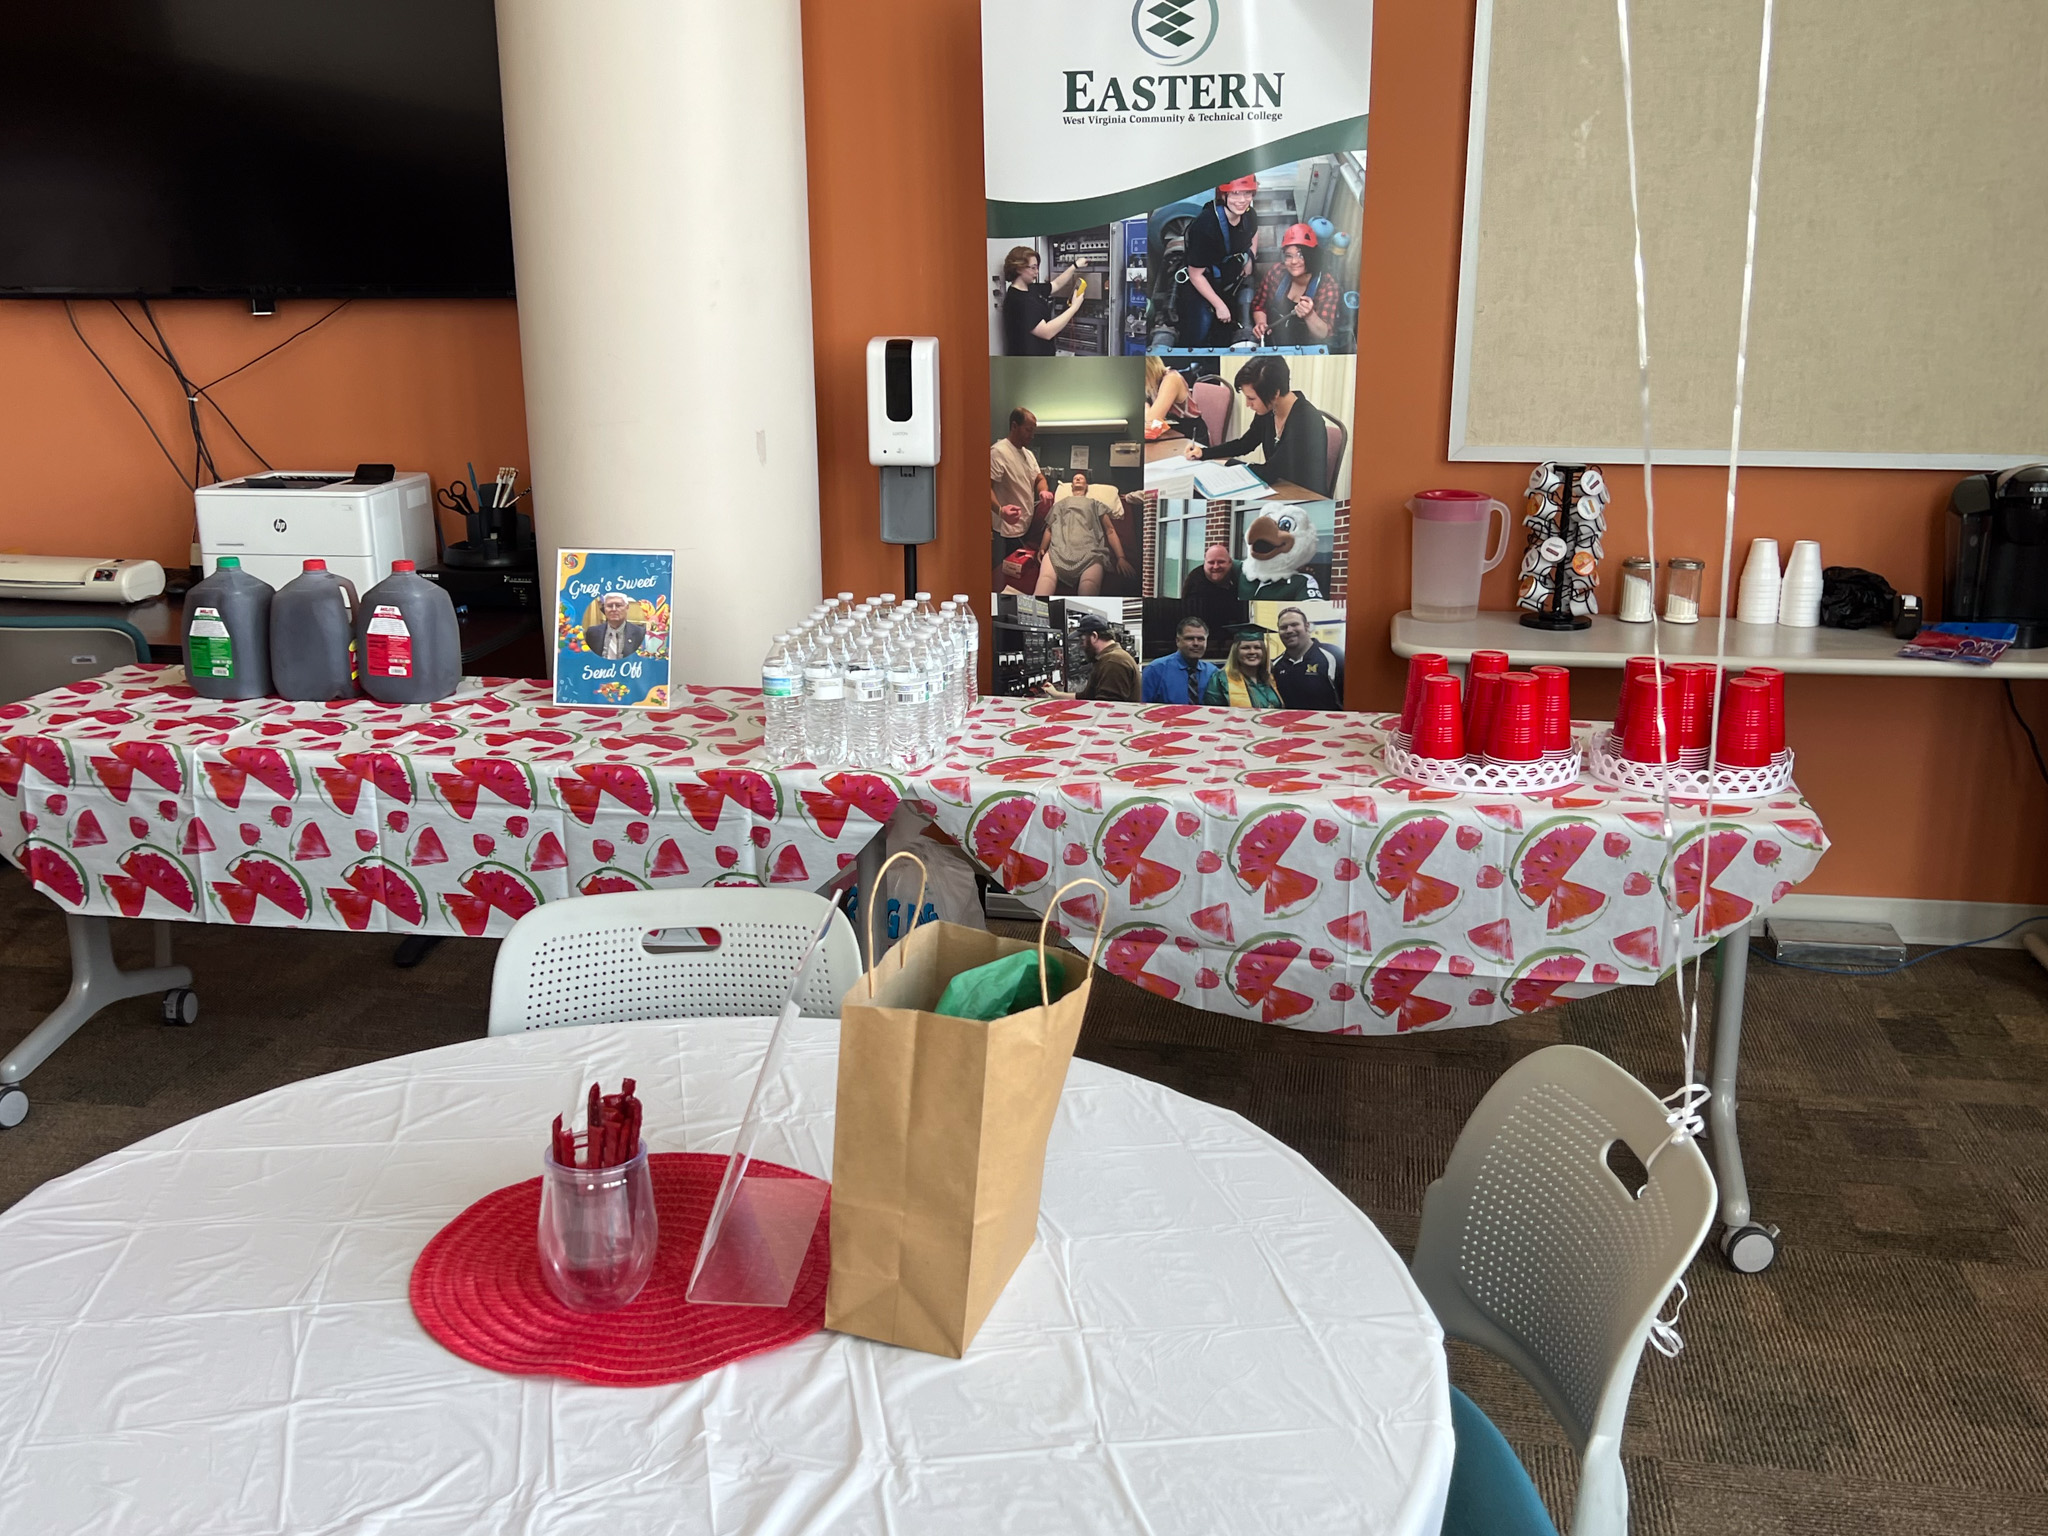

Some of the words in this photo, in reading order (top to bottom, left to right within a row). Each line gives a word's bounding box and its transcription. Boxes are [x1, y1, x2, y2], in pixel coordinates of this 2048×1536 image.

[1062, 70, 1285, 112] EASTERN
[1062, 116, 1085, 125] West
[1088, 115, 1127, 126] Virginia
[1129, 114, 1185, 125] Community
[1188, 113, 1196, 122] &
[1198, 111, 1244, 122] Technical
[1247, 111, 1283, 122] College
[273, 518, 288, 533] hp
[569, 577, 612, 598] Greg's
[616, 575, 659, 591] Sweet
[582, 664, 616, 680] Send
[620, 661, 642, 678] Off
